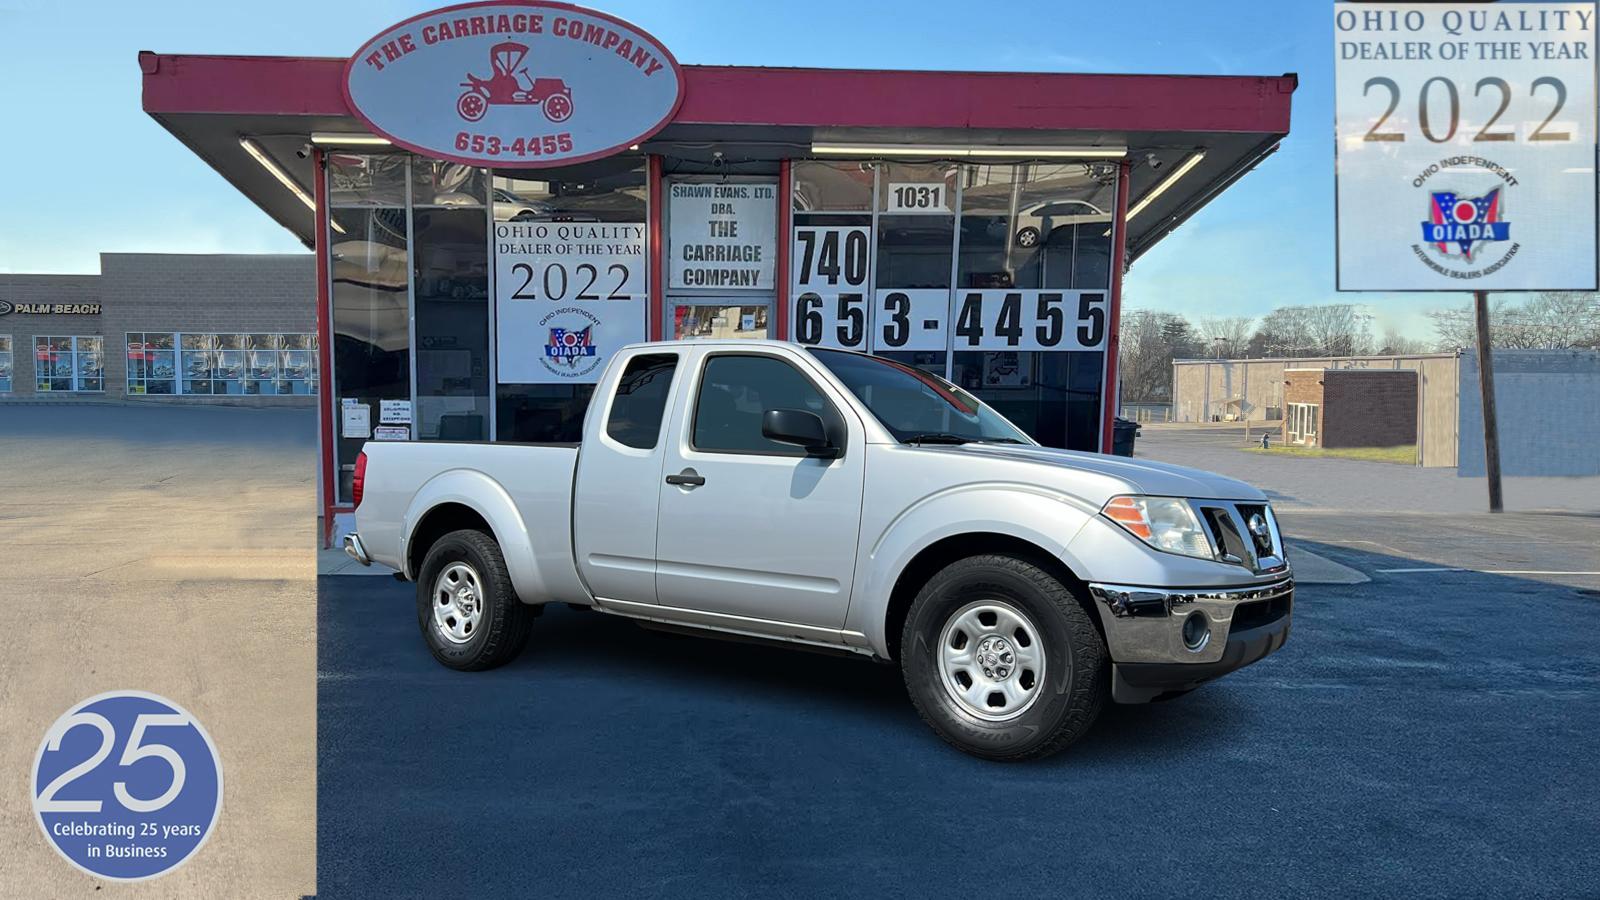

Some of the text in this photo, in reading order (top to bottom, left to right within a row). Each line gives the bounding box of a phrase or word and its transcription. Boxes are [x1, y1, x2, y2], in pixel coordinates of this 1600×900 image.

[1336, 10, 1593, 35] OHIO QUALITY
[366, 14, 664, 77] THE CARRIAGE COMPANY
[1340, 42, 1589, 60] DEALER OF THE YEAR
[1363, 76, 1571, 143] 2022
[455, 132, 573, 156] 653-4455
[1412, 155, 1519, 188] OHIO INDEPENDENT
[672, 186, 713, 199] SHAWN
[754, 187, 775, 199] LTD.
[894, 186, 941, 209] 1031
[497, 225, 644, 241] OHIO QUALITY
[709, 220, 738, 237] THE
[1432, 224, 1495, 240] OIADA
[499, 243, 642, 255] DEALER OF THE YEAR
[683, 245, 762, 262] CARRIAGE
[797, 230, 868, 286] 740
[510, 263, 631, 301] 2022
[683, 268, 760, 287] COMPANY
[15, 304, 100, 314] PALM BEACH
[551, 347, 588, 356] OIADA
